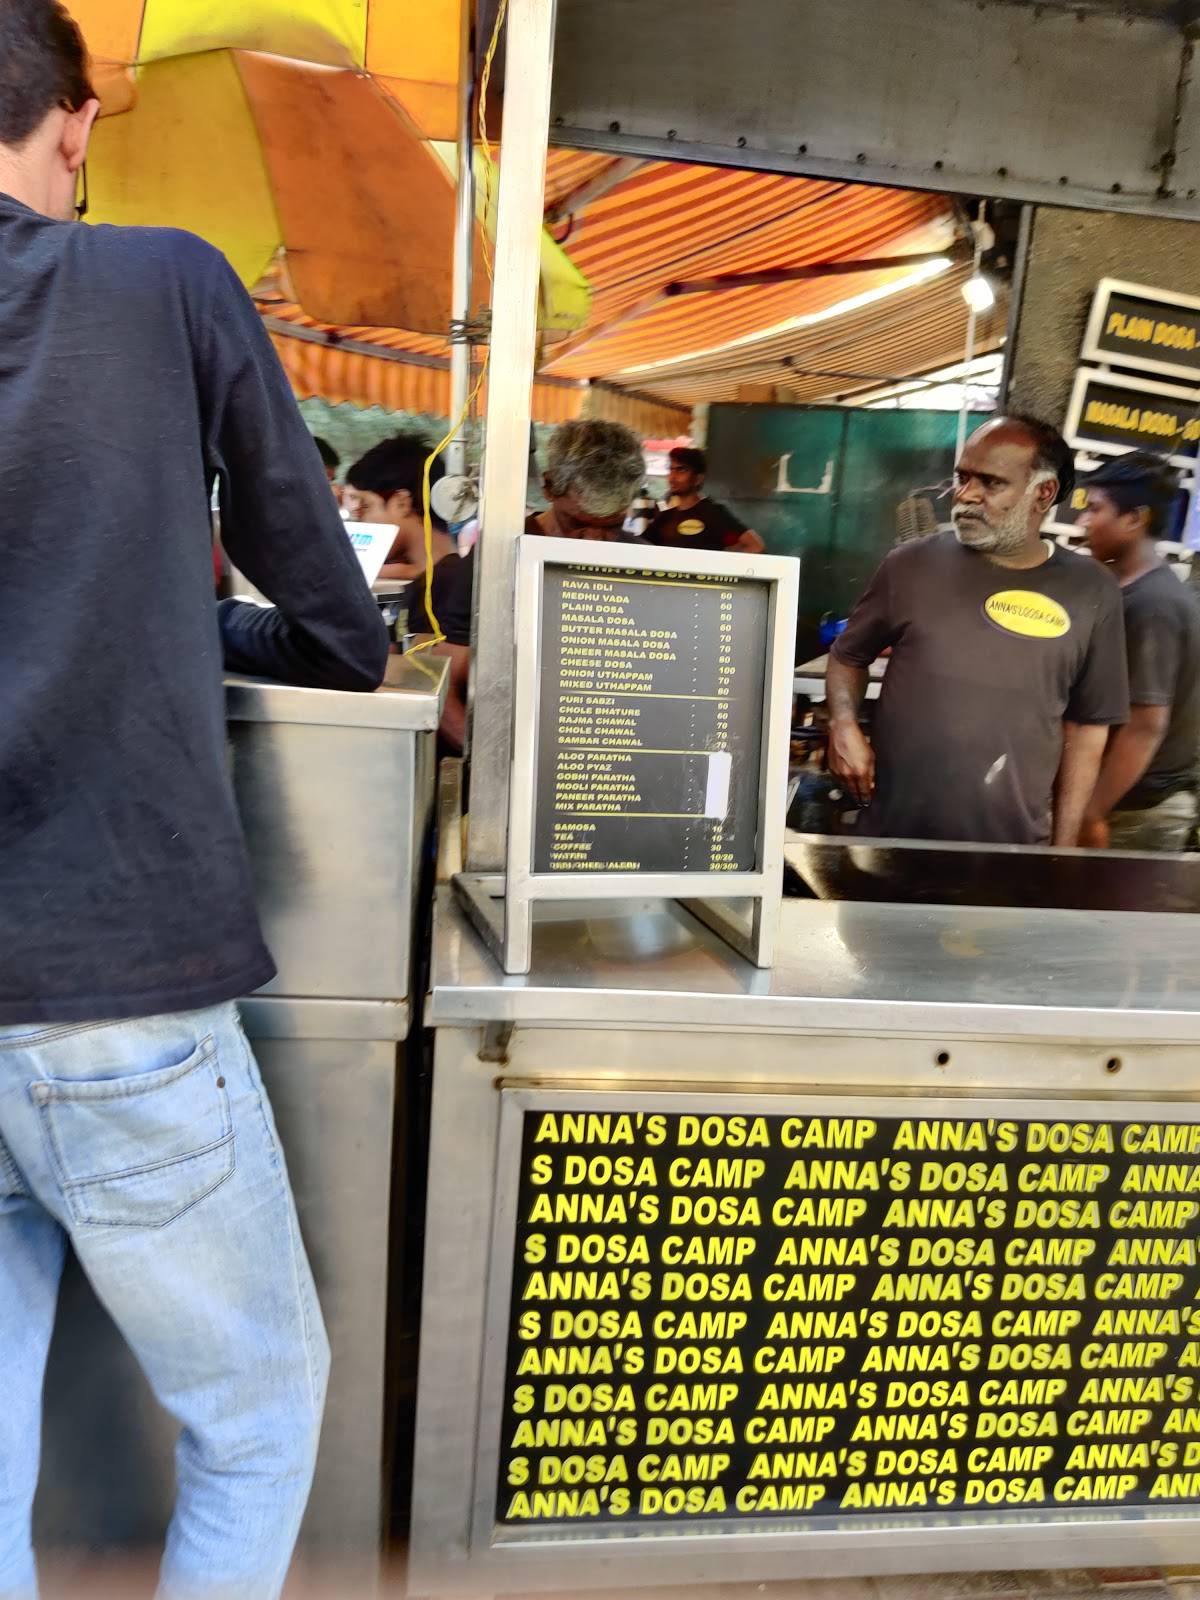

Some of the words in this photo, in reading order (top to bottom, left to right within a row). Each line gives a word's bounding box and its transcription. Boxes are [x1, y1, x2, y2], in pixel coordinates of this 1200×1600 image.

[562, 581, 590, 590] RAVA
[562, 592, 599, 601] MEDHU
[603, 594, 629, 603] VADA
[561, 603, 592, 612] PLAIN
[596, 605, 623, 614] DOSA
[561, 614, 604, 624] MASALA
[607, 617, 635, 625] DOSA
[561, 625, 602, 635] BUTTER
[606, 628, 647, 637] MASALA
[650, 630, 677, 639] DOSA
[561, 636, 595, 645] ONION
[598, 638, 640, 648] MASALA
[643, 641, 670, 649] DOSA
[561, 648, 601, 657] PANEER
[604, 649, 646, 659] MASALA
[649, 651, 676, 660] DOSA
[560, 658, 601, 668] CHEESE
[605, 660, 632, 669] DOSA
[560, 670, 594, 678] ONION
[598, 672, 653, 681] UTHAPPAM
[560, 680, 593, 689] MIXED
[596, 682, 651, 692] UTHAPPAM
[559, 696, 583, 705] PURI
[586, 697, 615, 706] SABZI
[559, 707, 592, 716] CHOLE
[595, 708, 640, 716] BHATURE
[559, 717, 593, 726] RAJMA
[596, 718, 636, 726] CHAWAL
[559, 727, 591, 735] CHOLE
[594, 728, 635, 736] CHAWAL
[558, 737, 599, 745] SAMBAR
[602, 738, 643, 746] CHAWAL
[558, 753, 584, 761] ALOO
[587, 754, 632, 762] PARATHA
[557, 763, 583, 771] ALOO
[557, 773, 588, 782] GOBHI
[591, 774, 635, 782] PARATHA
[556, 783, 588, 791] MOOLI
[590, 784, 635, 792] PARATHA
[596, 794, 641, 802] PARATHA
[555, 803, 574, 811] MIX
[535, 1113, 667, 1146] ANNA'S
[677, 1115, 770, 1148] DOSA
[780, 1117, 877, 1149] CAMP
[893, 1119, 1017, 1152] ANNA'S
[1026, 1122, 1110, 1153] DOSA
[531, 1154, 553, 1185] S
[564, 1155, 658, 1187] DOSA
[668, 1157, 766, 1189] CAMP
[783, 1158, 910, 1192] ANNA'S
[919, 1161, 1008, 1193] DOSA
[1017, 1163, 1107, 1193] CAMP
[529, 1191, 660, 1225] ANNA'S
[670, 1195, 762, 1226] DOSA
[771, 1196, 868, 1227] CAMP
[882, 1196, 1006, 1229] ANNA'S
[1013, 1199, 1097, 1229] DOSA
[1109, 1200, 1195, 1229] CAMP
[525, 1233, 546, 1264] S
[558, 1233, 650, 1265] DOSA
[661, 1235, 756, 1265] CAMP
[775, 1234, 901, 1267] ANNA'S
[908, 1237, 995, 1267] DOSA
[1004, 1238, 1095, 1266] CAMP
[524, 1268, 651, 1301] ANNA'S
[662, 1272, 753, 1302] DOSA
[762, 1272, 857, 1302] CAMP
[871, 1270, 993, 1302] ANNA'S
[1001, 1272, 1085, 1301] DOSA
[1094, 1272, 1183, 1301] CAMP
[520, 1310, 541, 1340] S
[552, 1309, 643, 1340] DOSA
[653, 1310, 748, 1340] CAMP
[766, 1308, 888, 1340] ANNA'S
[896, 1310, 983, 1339] DOSA
[991, 1309, 1081, 1338] CAMP
[518, 1342, 645, 1375] ANNA'S
[655, 1346, 744, 1375] DOSA
[753, 1345, 846, 1374] CAMP
[861, 1342, 980, 1372] ANNA'S
[987, 1343, 1072, 1371] DOSA
[1080, 1341, 1167, 1370] CAMP
[513, 1384, 535, 1414] S
[545, 1383, 636, 1413] DOSA
[645, 1383, 739, 1412] CAMP
[756, 1379, 878, 1411] ANNA'S
[885, 1380, 970, 1409] DOSA
[978, 1378, 1067, 1407] CAMP
[1078, 1375, 1193, 1405] ANNA'S
[513, 1416, 638, 1448] ANNA'S
[647, 1417, 735, 1446] DOSA
[745, 1416, 836, 1444] CAMP
[851, 1410, 967, 1442] ANNA'S
[975, 1411, 1059, 1439] DOSA
[1066, 1408, 1150, 1437] CAMP
[510, 1457, 529, 1486] S
[539, 1455, 629, 1485] DOSA
[637, 1453, 730, 1482] CAMP
[748, 1447, 867, 1479] ANNA'S
[875, 1448, 958, 1477] DOSA
[967, 1445, 1053, 1473] CAMP
[1066, 1440, 1178, 1470] ANNA'S
[509, 1486, 630, 1518] ANNA'S
[641, 1487, 726, 1515] DOSA
[737, 1484, 826, 1512] CAMP
[841, 1477, 957, 1508] ANNA'S
[964, 1477, 1044, 1505] DOSA
[1053, 1474, 1138, 1502] CAMP
